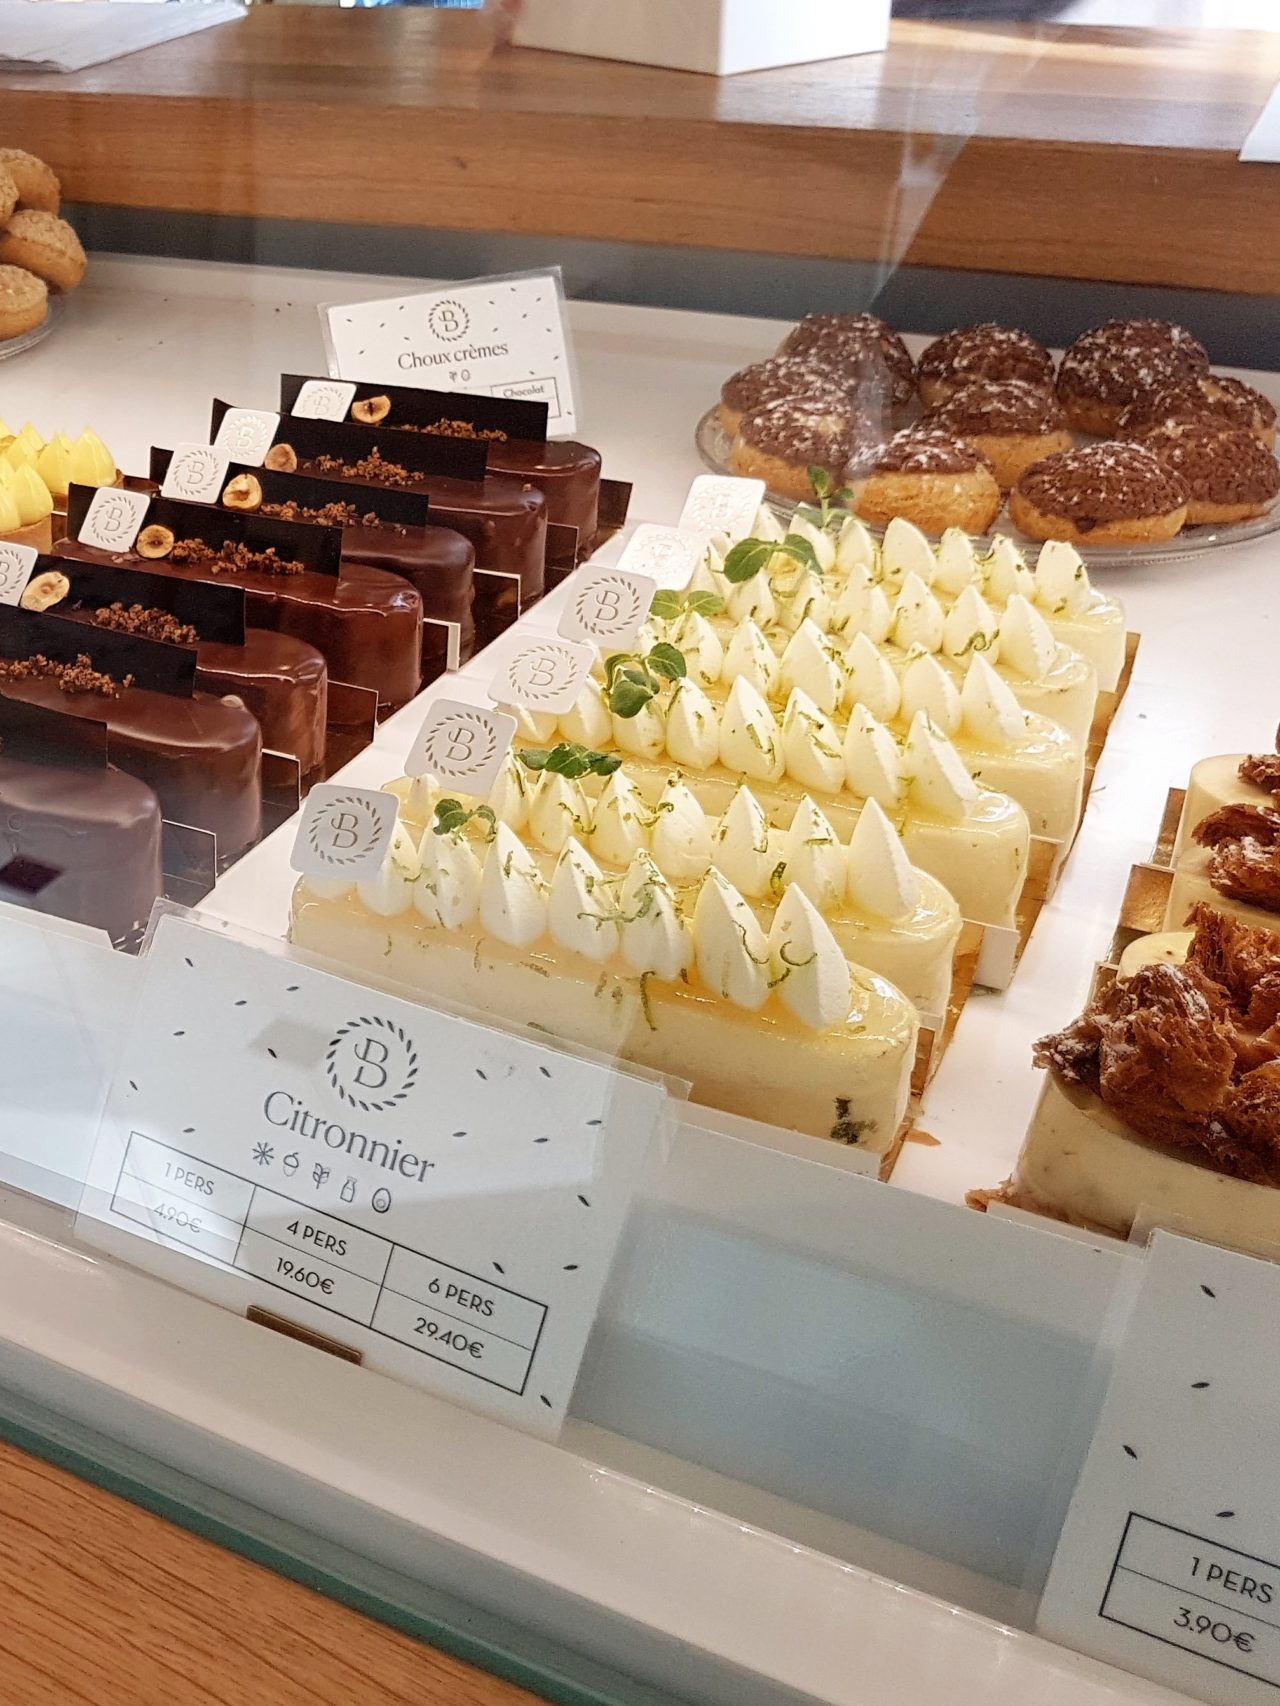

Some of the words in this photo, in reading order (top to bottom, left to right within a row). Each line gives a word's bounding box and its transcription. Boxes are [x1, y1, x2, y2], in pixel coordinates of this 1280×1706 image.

[439, 309, 459, 333] B
[397, 352, 451, 371] Choux
[453, 342, 509, 363] crèmes
[503, 384, 545, 397] Chocolat
[595, 590, 621, 621] B
[528, 657, 557, 687] B
[445, 727, 476, 762] B
[330, 812, 359, 849] B
[353, 1037, 389, 1089] B
[263, 1089, 436, 1184] Citronnier
[174, 1164, 215, 1197] PERS
[153, 1201, 202, 1234] 4.90€
[286, 1220, 299, 1237] 4
[302, 1224, 348, 1257] PERS
[276, 1256, 336, 1296] 19.60€
[428, 1278, 441, 1295] 6
[445, 1284, 495, 1318] PERS
[413, 1317, 485, 1361] 29.40€
[1206, 1563, 1274, 1604] PERS
[1174, 1606, 1257, 1654] 3.90€
